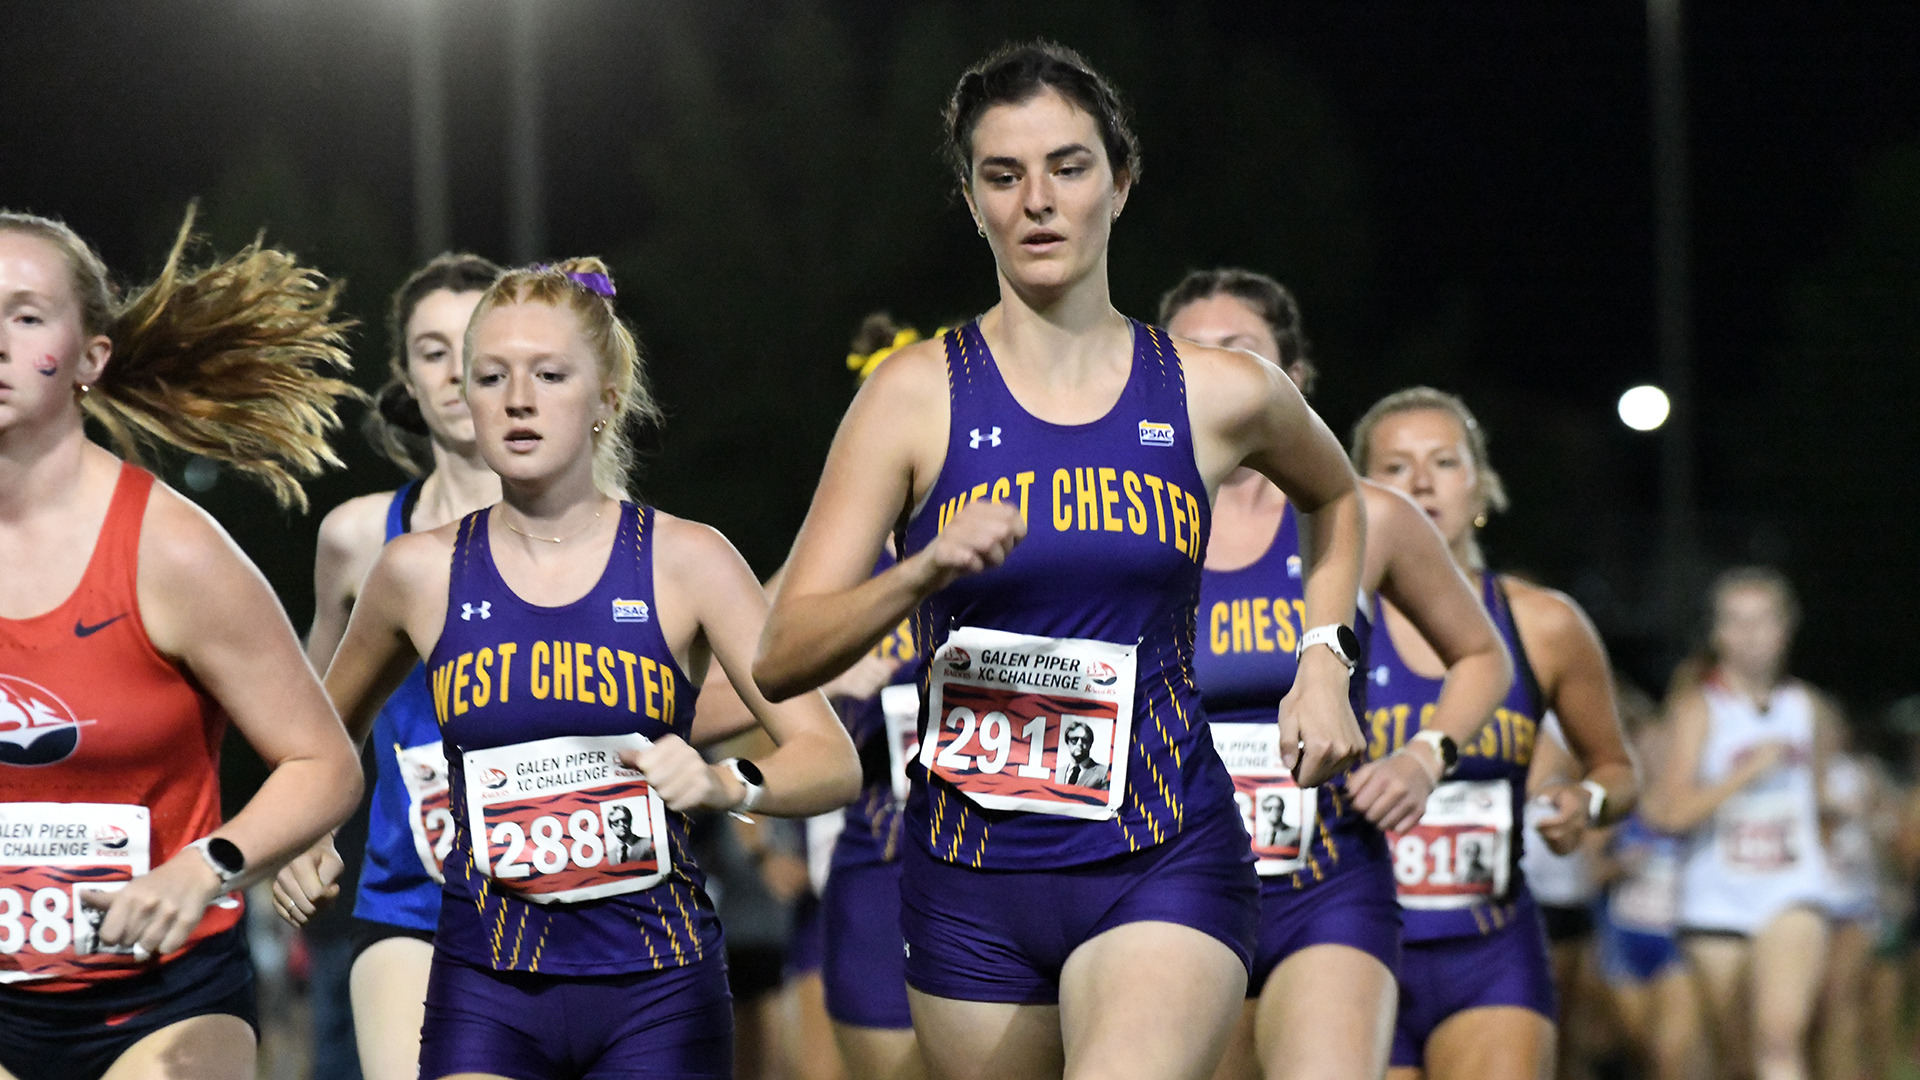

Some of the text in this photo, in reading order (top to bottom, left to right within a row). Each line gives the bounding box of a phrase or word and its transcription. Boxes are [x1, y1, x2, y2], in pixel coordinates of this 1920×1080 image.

[1140, 428, 1172, 440] PSAC
[1052, 467, 1201, 564] CHESTER
[981, 649, 1081, 673] GALEN PIPER
[432, 640, 676, 727] WEST CHESTER
[978, 667, 1081, 691] XC CHALLENGE
[937, 706, 1051, 780] 291
[516, 750, 607, 776] GALEN PIPER
[516, 778, 533, 793] XC
[536, 765, 610, 791] CHALLENGE
[39, 823, 88, 838] PIPER
[490, 808, 605, 879] 288
[3, 843, 90, 857] CHALLENGE
